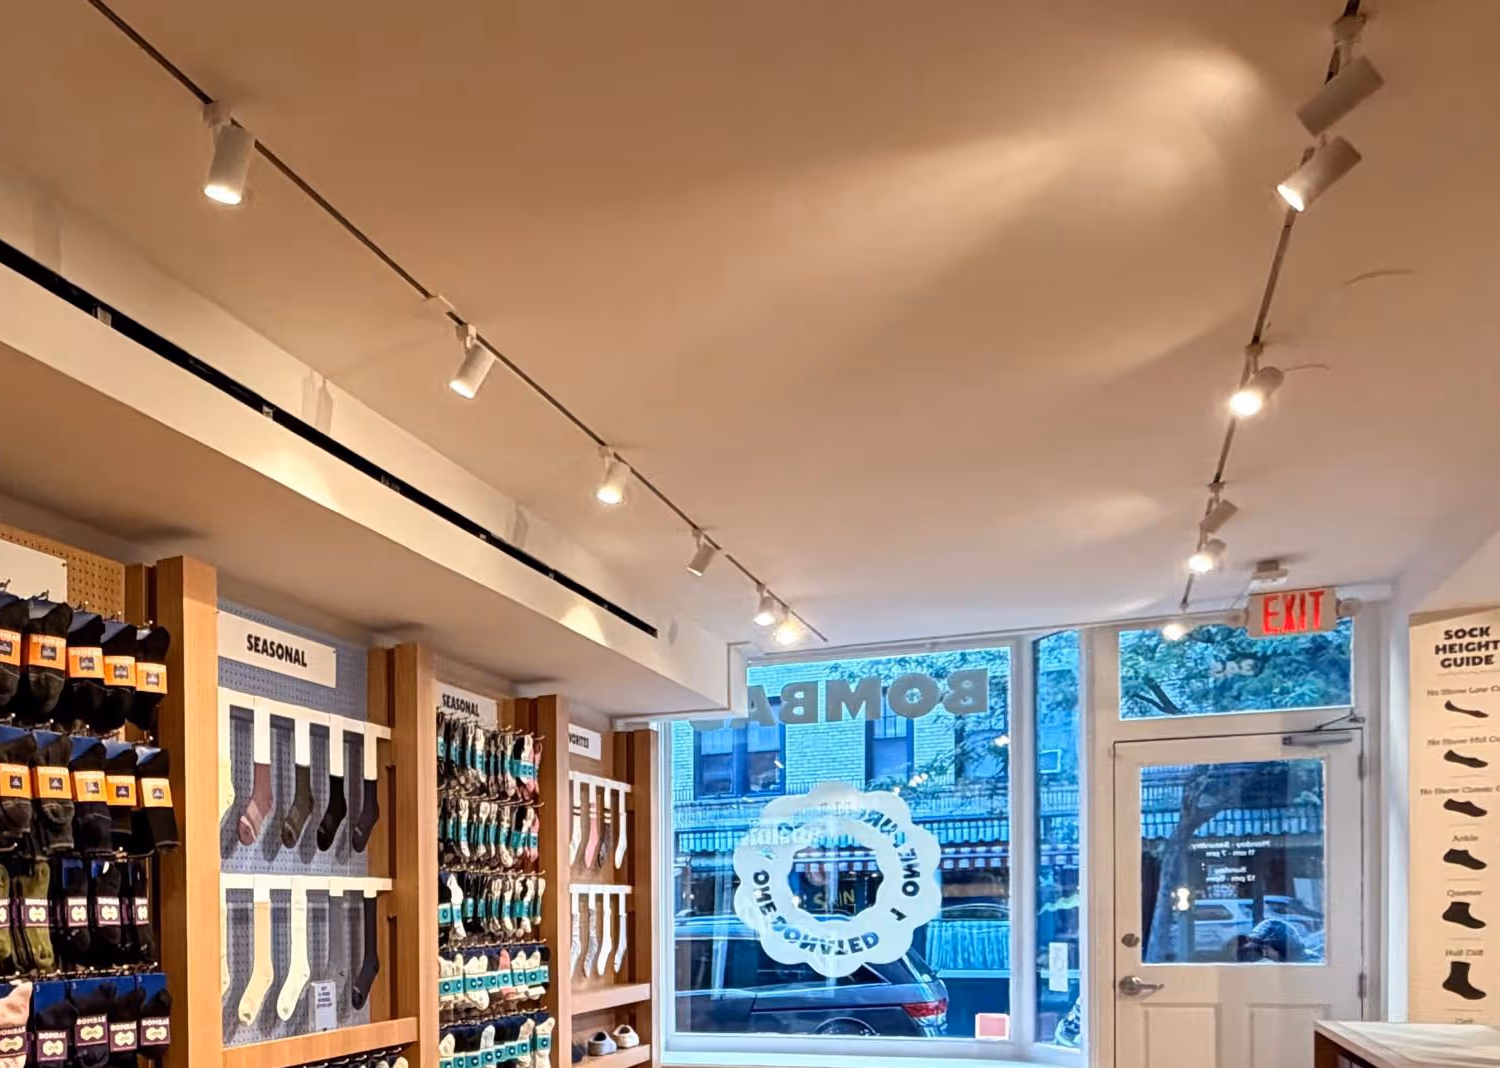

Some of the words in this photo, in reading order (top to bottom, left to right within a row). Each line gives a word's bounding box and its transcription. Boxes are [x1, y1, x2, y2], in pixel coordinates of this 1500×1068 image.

[1263, 591, 1325, 635] EXIT
[1444, 626, 1491, 640] SOCK
[247, 634, 307, 668] SEASONAL
[1435, 640, 1500, 655] HEIGHT
[1440, 655, 1494, 668] GUIDE
[442, 694, 479, 717] SEASONAL
